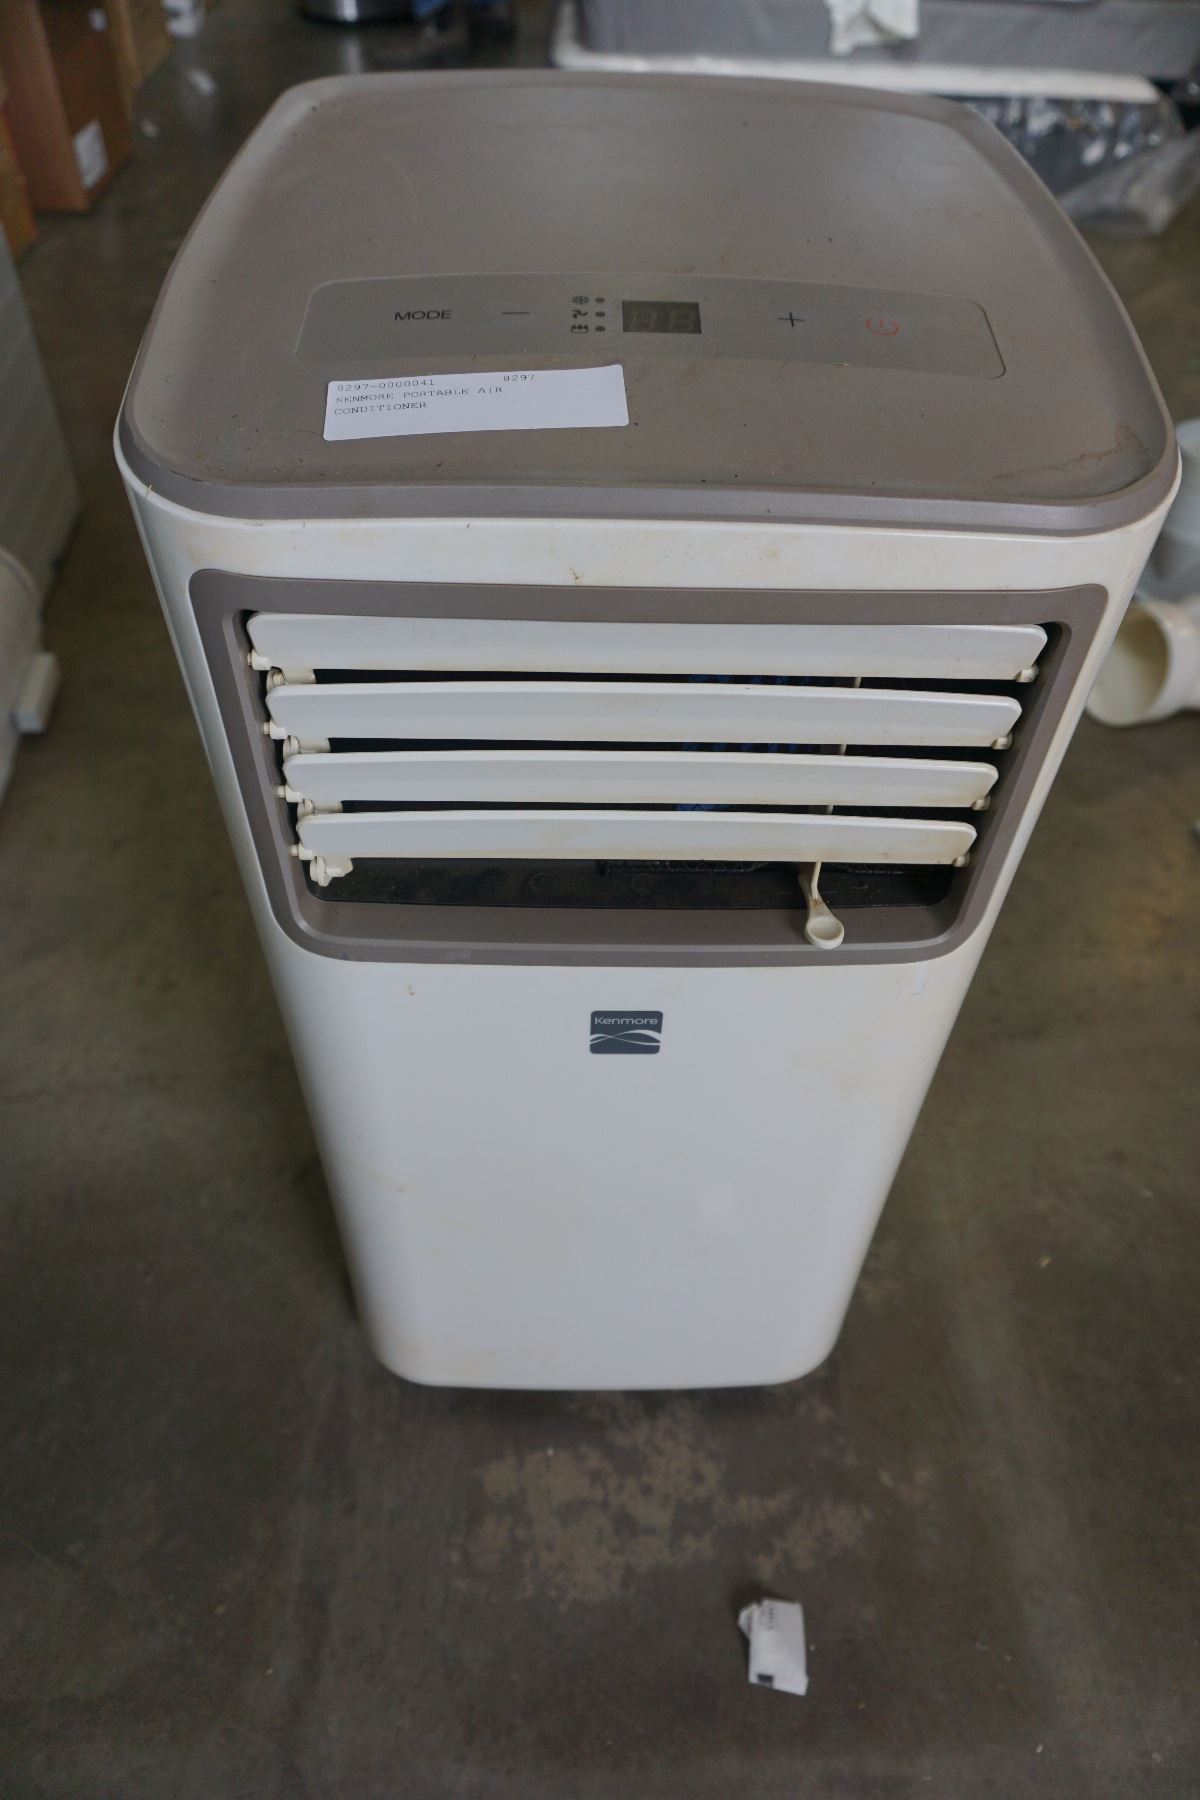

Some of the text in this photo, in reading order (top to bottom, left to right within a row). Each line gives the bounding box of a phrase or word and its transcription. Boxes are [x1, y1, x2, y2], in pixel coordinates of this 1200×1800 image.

[394, 310, 452, 321] MODE
[336, 386, 503, 404] KENMORE PORTABLE AIR
[334, 402, 427, 415] CONDITIONER
[594, 1016, 658, 1025] Kenmore
